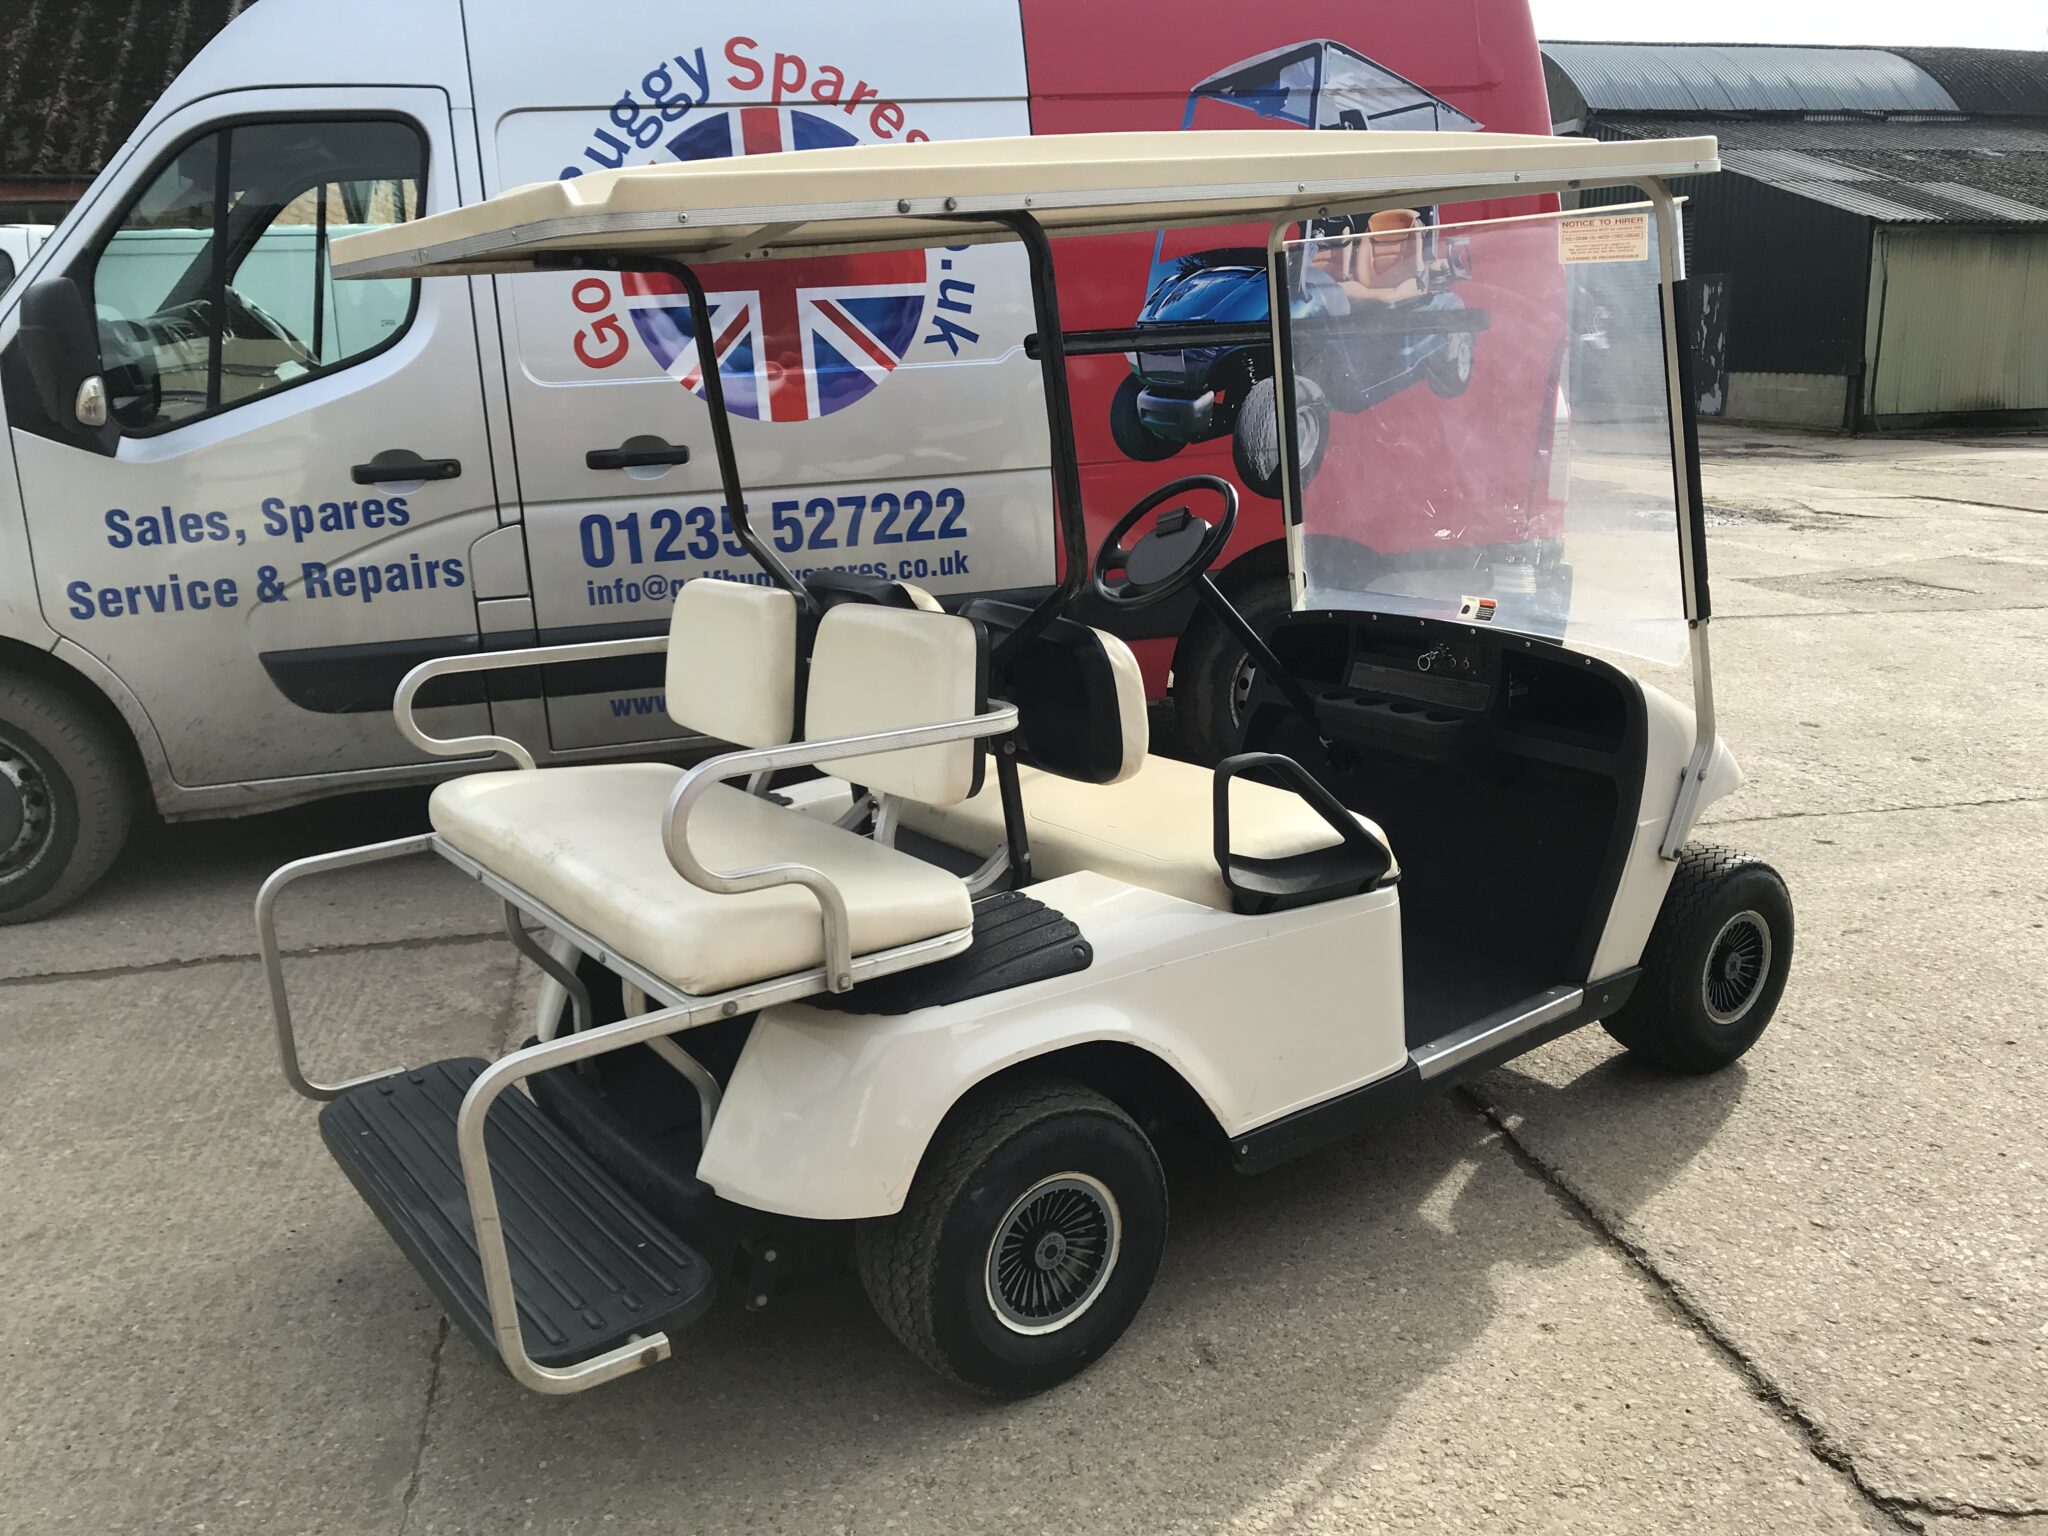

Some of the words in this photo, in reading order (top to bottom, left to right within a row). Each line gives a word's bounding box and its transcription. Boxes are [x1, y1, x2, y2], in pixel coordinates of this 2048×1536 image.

[559, 46, 711, 181] uggy
[1562, 220, 1595, 228] NOTICE
[1615, 216, 1644, 225] HIRER
[571, 277, 630, 369] Go
[924, 244, 981, 357] .uk
[104, 505, 247, 549] Sales,
[260, 496, 411, 543] Spares
[772, 487, 968, 554] 527222
[66, 574, 239, 621] Service
[256, 564, 289, 603] &
[301, 552, 465, 603] Repairs
